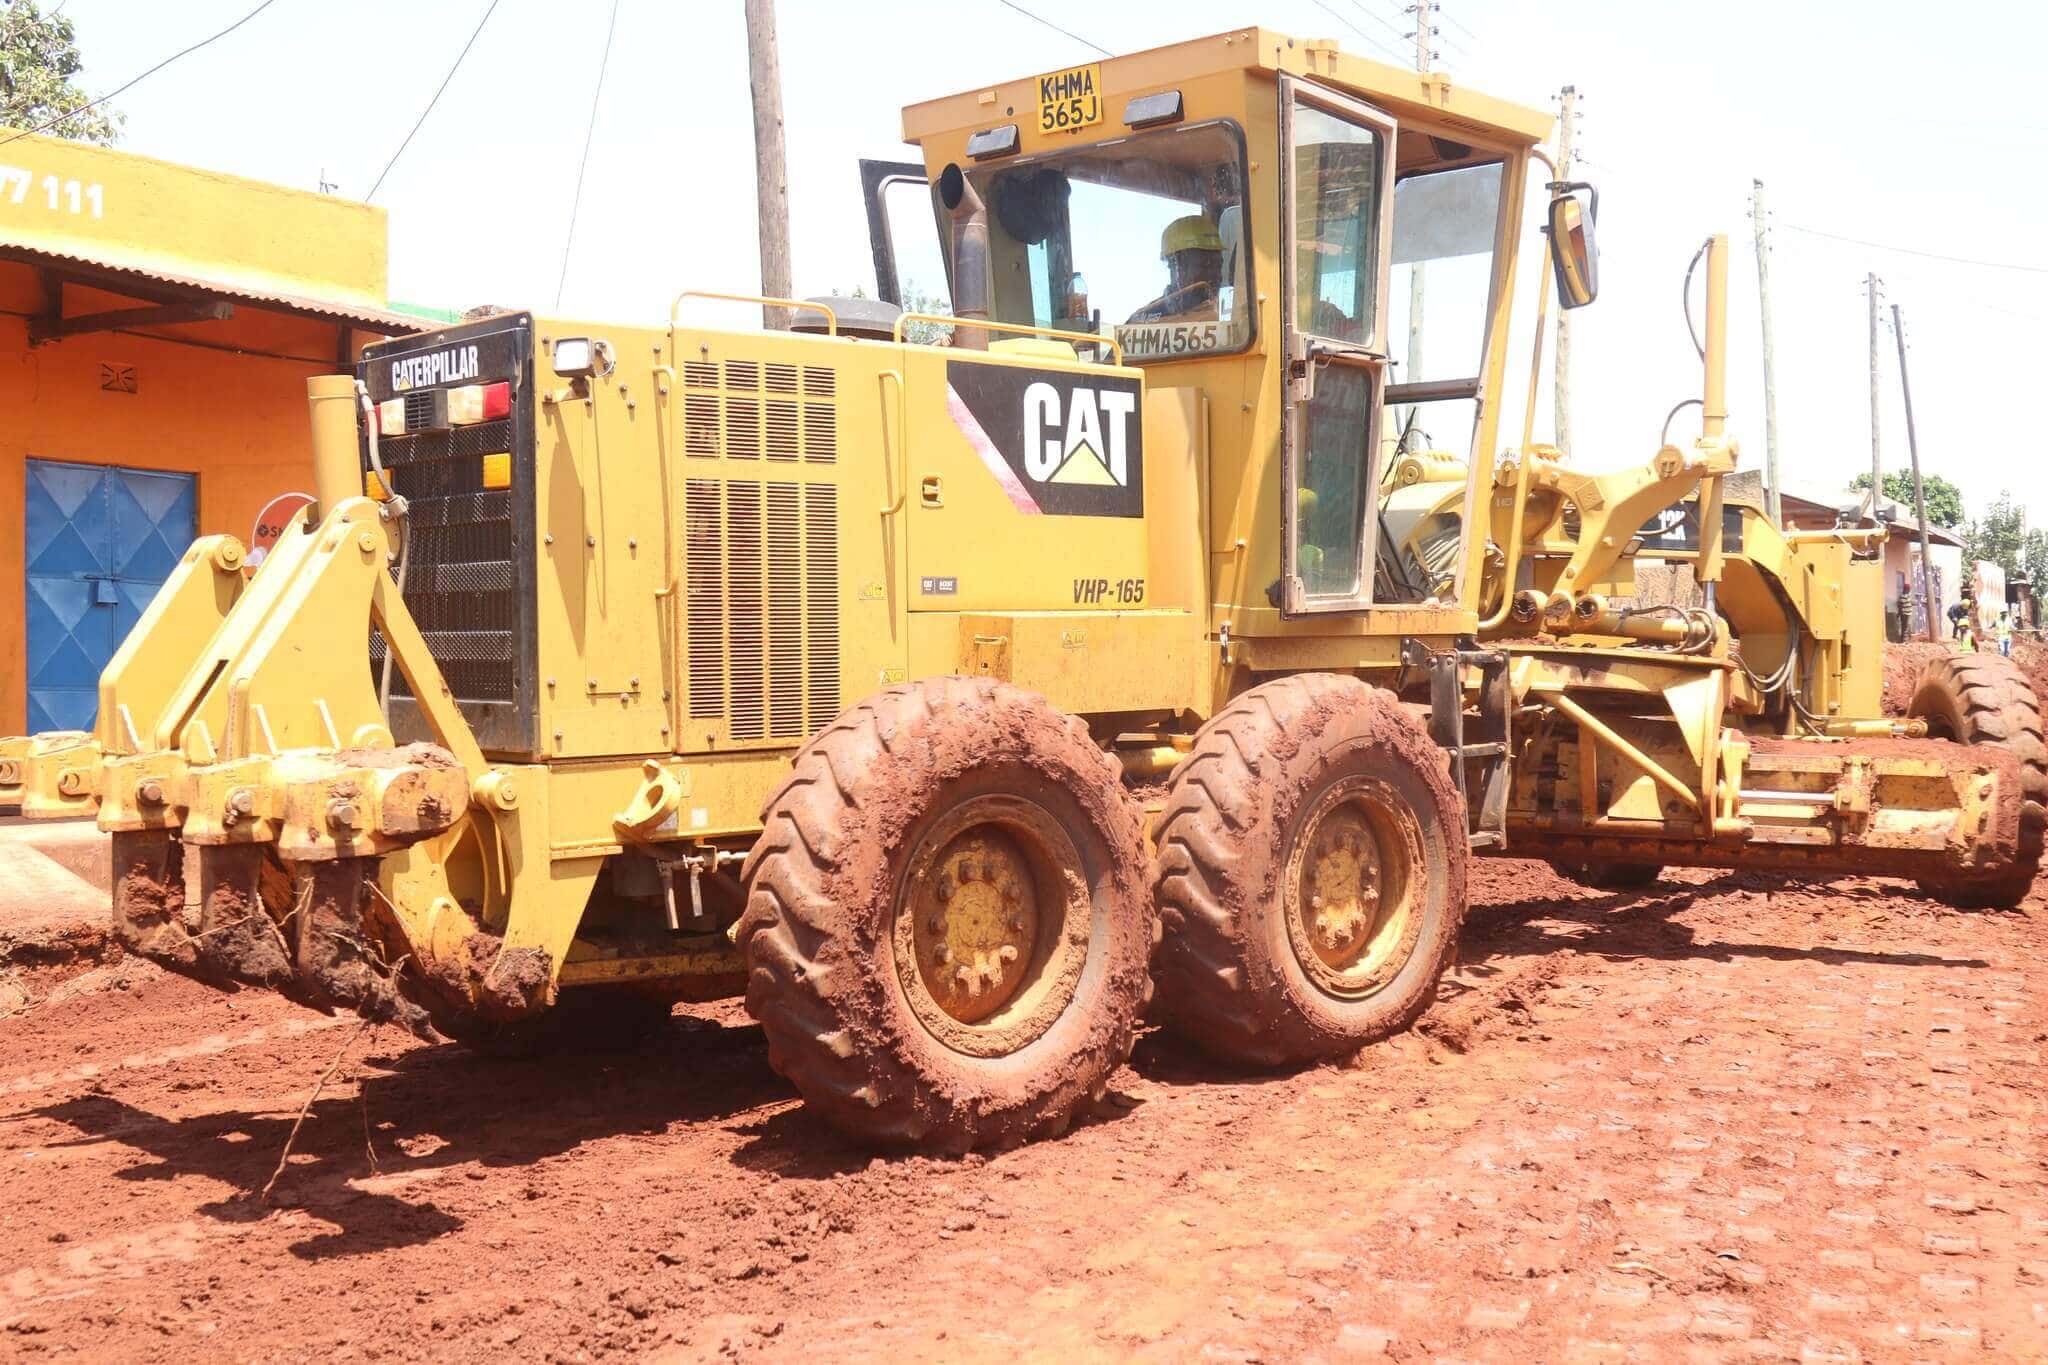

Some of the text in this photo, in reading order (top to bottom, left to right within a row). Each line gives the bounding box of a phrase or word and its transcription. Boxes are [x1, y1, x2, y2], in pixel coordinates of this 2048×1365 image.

[1041, 69, 1093, 103] KHMA
[1042, 96, 1096, 129] 565J
[42, 174, 104, 219] 111
[392, 346, 478, 391] CATERPILLAR
[1024, 382, 1135, 487] CAT
[1073, 579, 1145, 603] VHP-165
